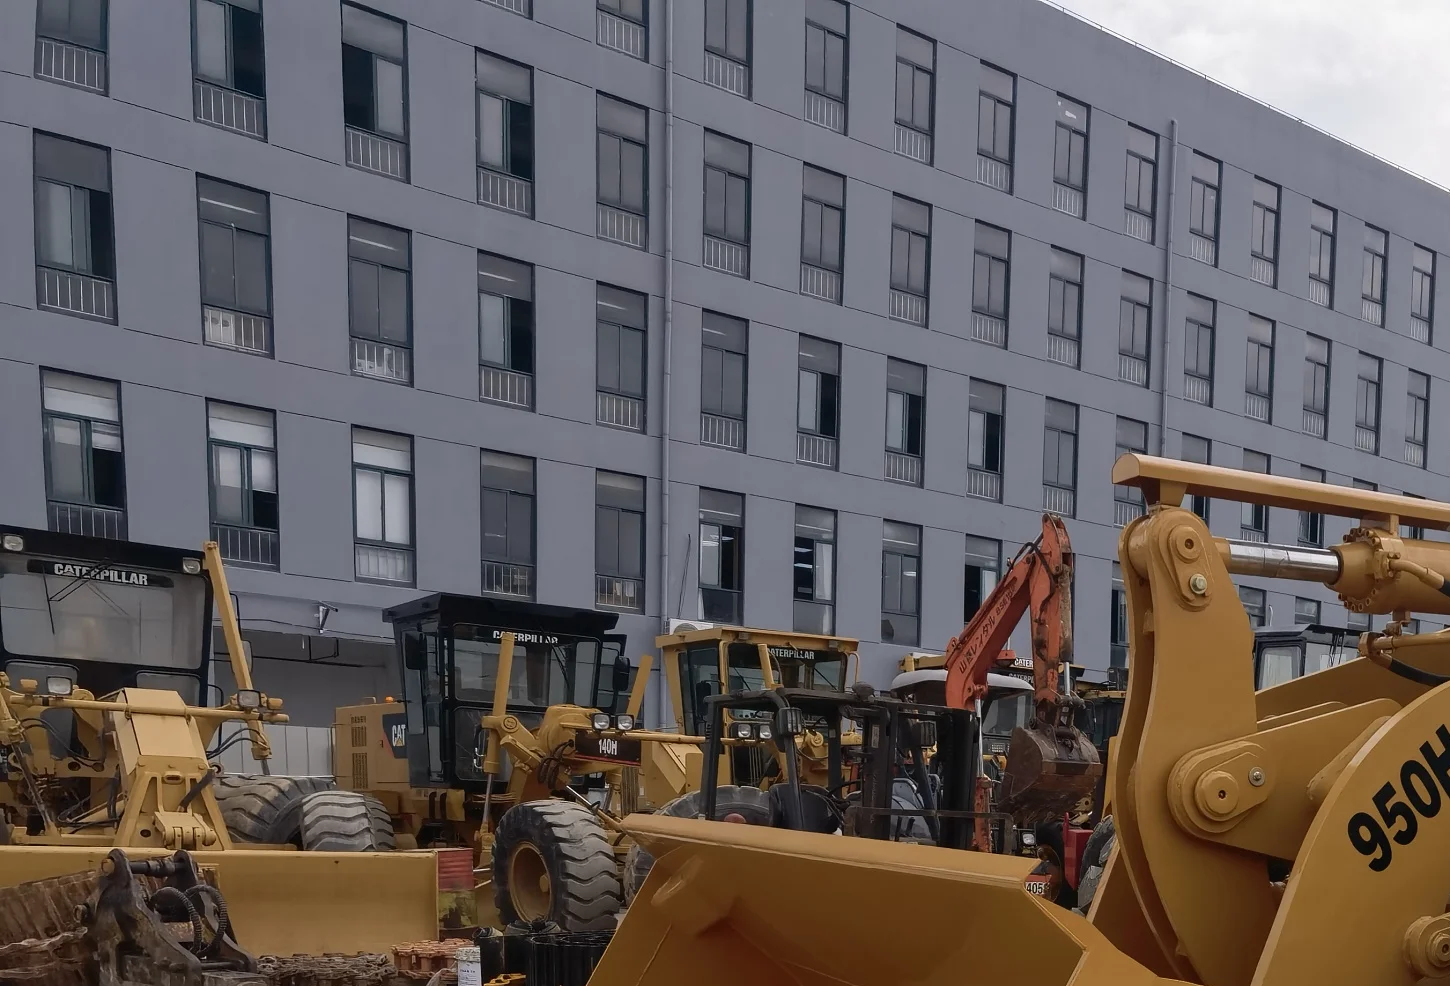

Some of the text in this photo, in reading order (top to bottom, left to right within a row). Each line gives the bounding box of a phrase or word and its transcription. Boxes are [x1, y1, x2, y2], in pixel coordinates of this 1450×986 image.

[54, 563, 149, 586] CATERPILLAR
[493, 630, 559, 644] CERPILLAR
[1014, 657, 1034, 668] CATER
[392, 724, 406, 747] CAT
[598, 738, 618, 756] 140H
